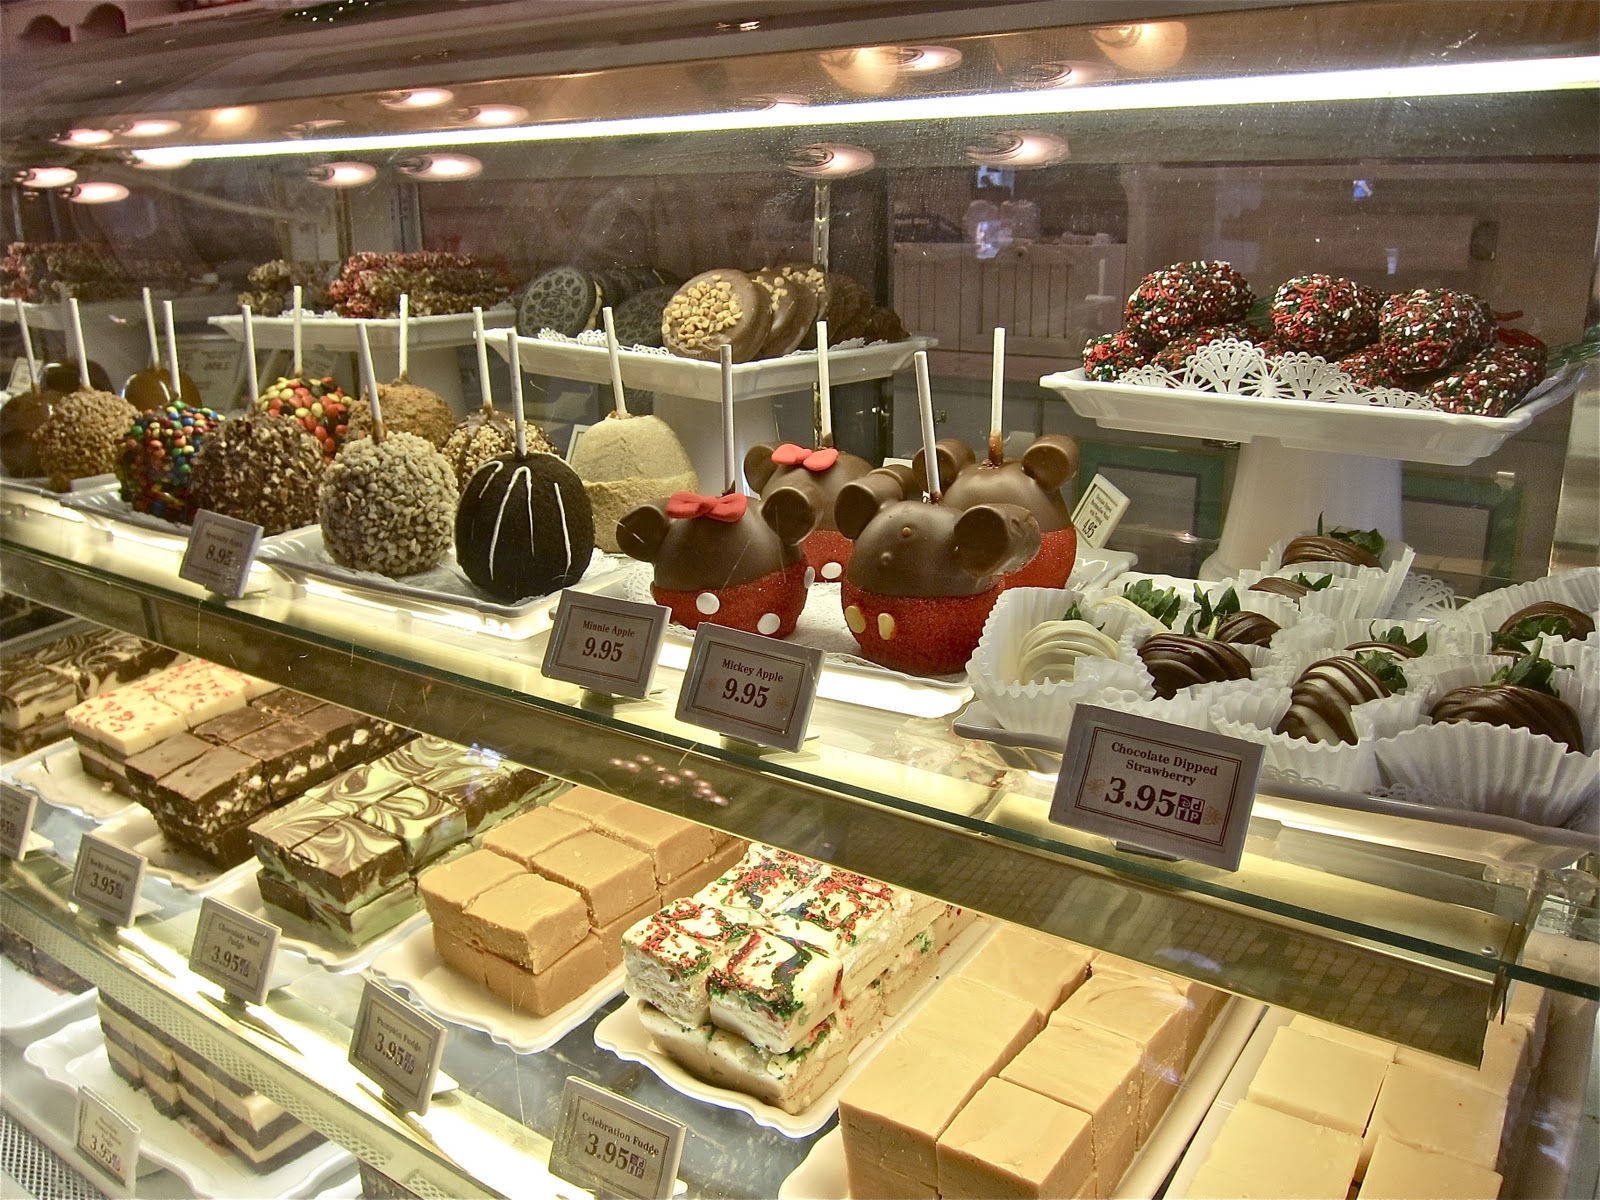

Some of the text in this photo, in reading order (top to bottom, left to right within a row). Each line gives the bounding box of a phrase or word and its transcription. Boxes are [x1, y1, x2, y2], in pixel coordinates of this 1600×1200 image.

[206, 544, 233, 566] 8.95
[583, 620, 635, 638] Minnie Apple
[582, 637, 624, 662] 9.95
[722, 658, 784, 682] Mickey Apple
[722, 678, 770, 708] 9.95
[1111, 741, 1219, 776] Chocolate Dipped
[1126, 759, 1197, 786] Strawberry
[1104, 776, 1178, 817] 3.95
[91, 872, 115, 895] 3.95
[211, 945, 240, 972] 3.95
[377, 1016, 421, 1052] Pumpkin Fudge
[374, 1032, 405, 1067] 3.95
[582, 1111, 659, 1156] Celebration Fudge
[584, 1131, 630, 1170] 3.95
